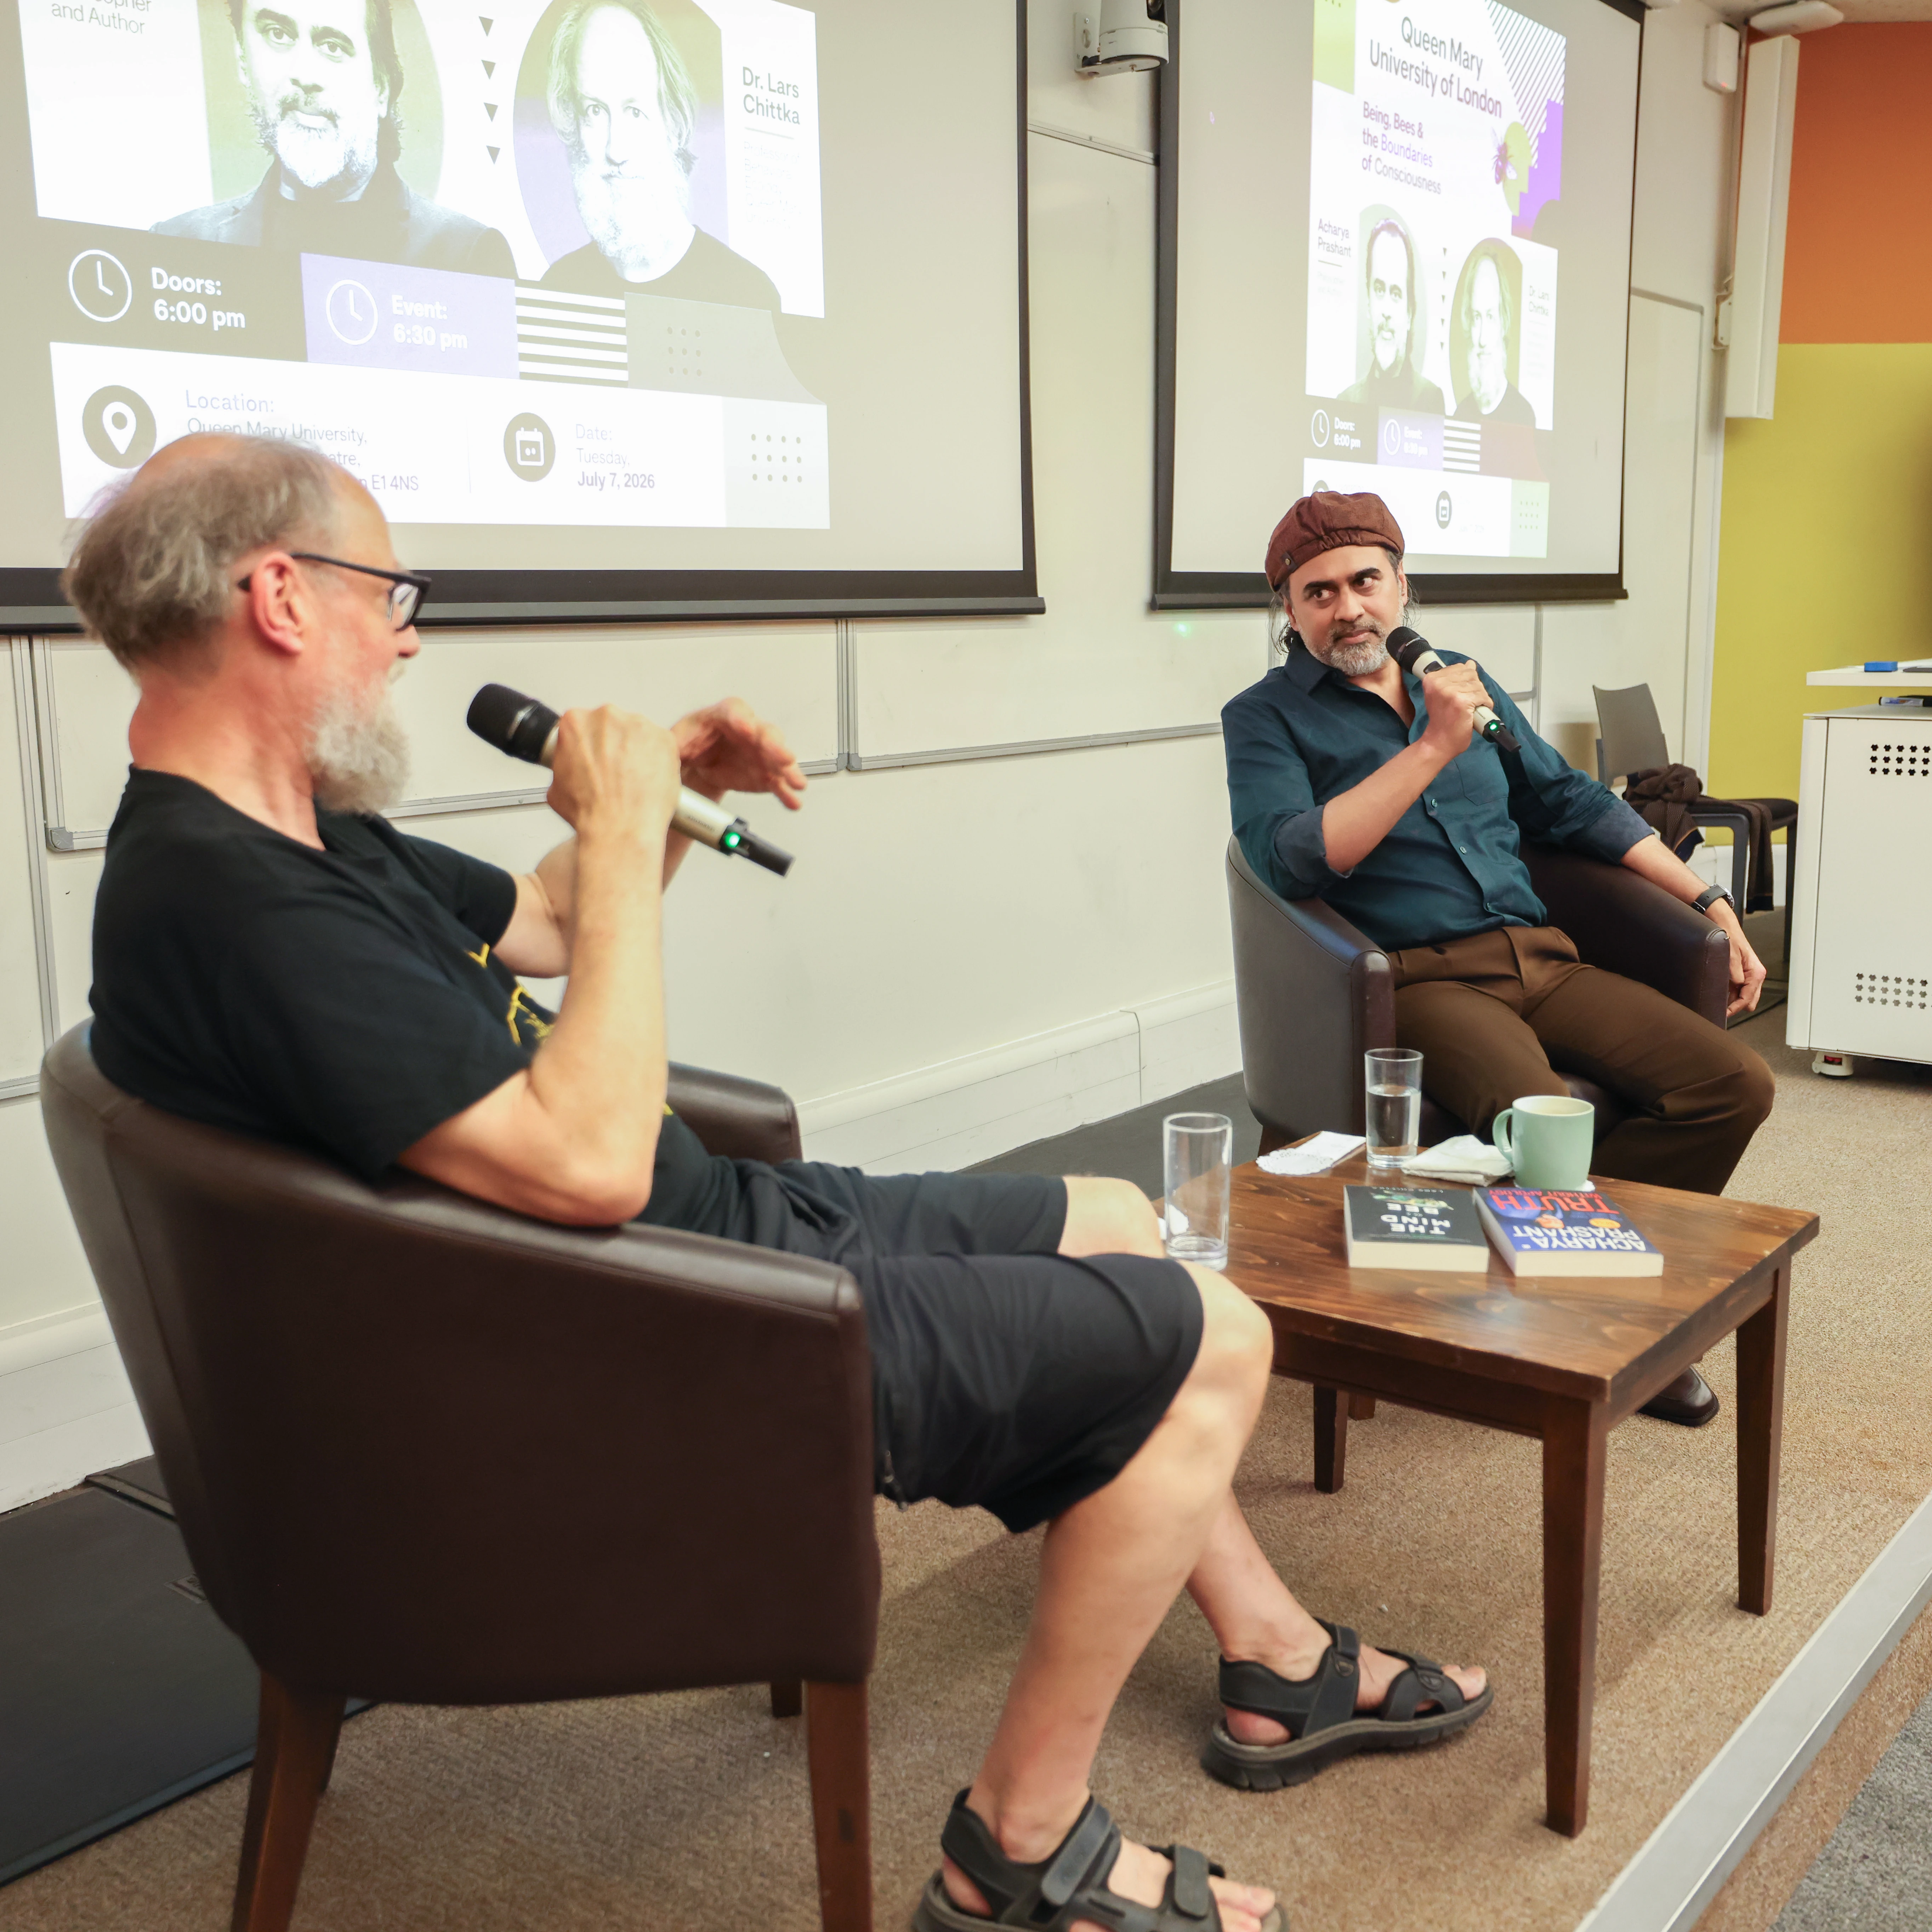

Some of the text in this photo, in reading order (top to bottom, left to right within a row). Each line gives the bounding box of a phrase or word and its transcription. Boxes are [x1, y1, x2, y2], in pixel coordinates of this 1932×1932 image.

[51, 3, 145, 34] and Author
[1402, 17, 1483, 81] Queen Mary
[743, 66, 799, 98] Dr. Lars
[1370, 39, 1502, 118] University of London
[744, 94, 800, 124] Chittka
[1363, 101, 1424, 138] Being, Bees &
[1363, 127, 1433, 167] the Boundaries
[1362, 155, 1441, 195] of Consciousness
[1318, 218, 1349, 241] Acharya
[1318, 236, 1351, 257] Prashant
[152, 267, 222, 296] Doors:
[154, 299, 245, 330] 6:00 pm
[391, 295, 448, 320] Event:
[393, 323, 468, 352] 6:30 pm
[185, 390, 274, 413] Location:
[247, 421, 288, 441] Mary
[292, 423, 367, 447] University,
[576, 424, 612, 441] Date:
[1334, 417, 1355, 431] Doors:
[1334, 434, 1361, 450] 6:00 pm
[328, 451, 361, 467] atre,
[576, 448, 630, 468] Tuesday,
[578, 471, 655, 491] July 7, 2026
[1386, 1203, 1439, 1215] BEE
[1491, 1195, 1620, 1214] TRUTH
[1380, 1214, 1451, 1228] MIND
[1390, 1223, 1445, 1235] THE
[1512, 1225, 1641, 1240] PRASHANT
[1530, 1236, 1647, 1251] ACHARYA
